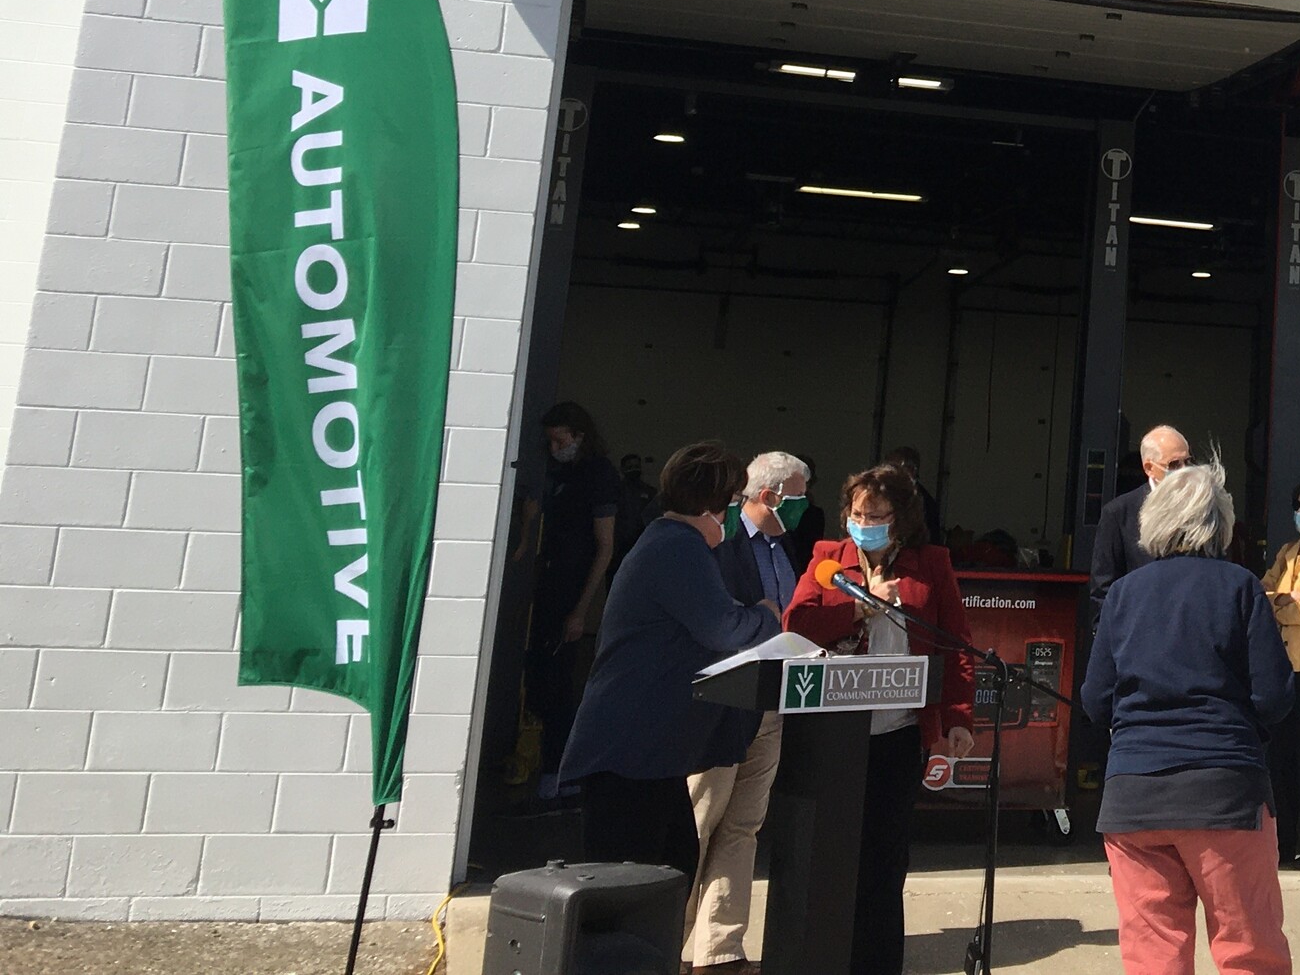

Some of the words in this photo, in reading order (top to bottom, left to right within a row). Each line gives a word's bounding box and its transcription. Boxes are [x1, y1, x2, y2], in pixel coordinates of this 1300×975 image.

[1104, 150, 1130, 266] TITAN
[290, 69, 370, 665] AUTOMOTIVE
[826, 690, 882, 701] COMMUNITY
[883, 689, 920, 698] COLLEGE
[828, 670, 863, 690] IVY
[868, 668, 920, 688] TECH
